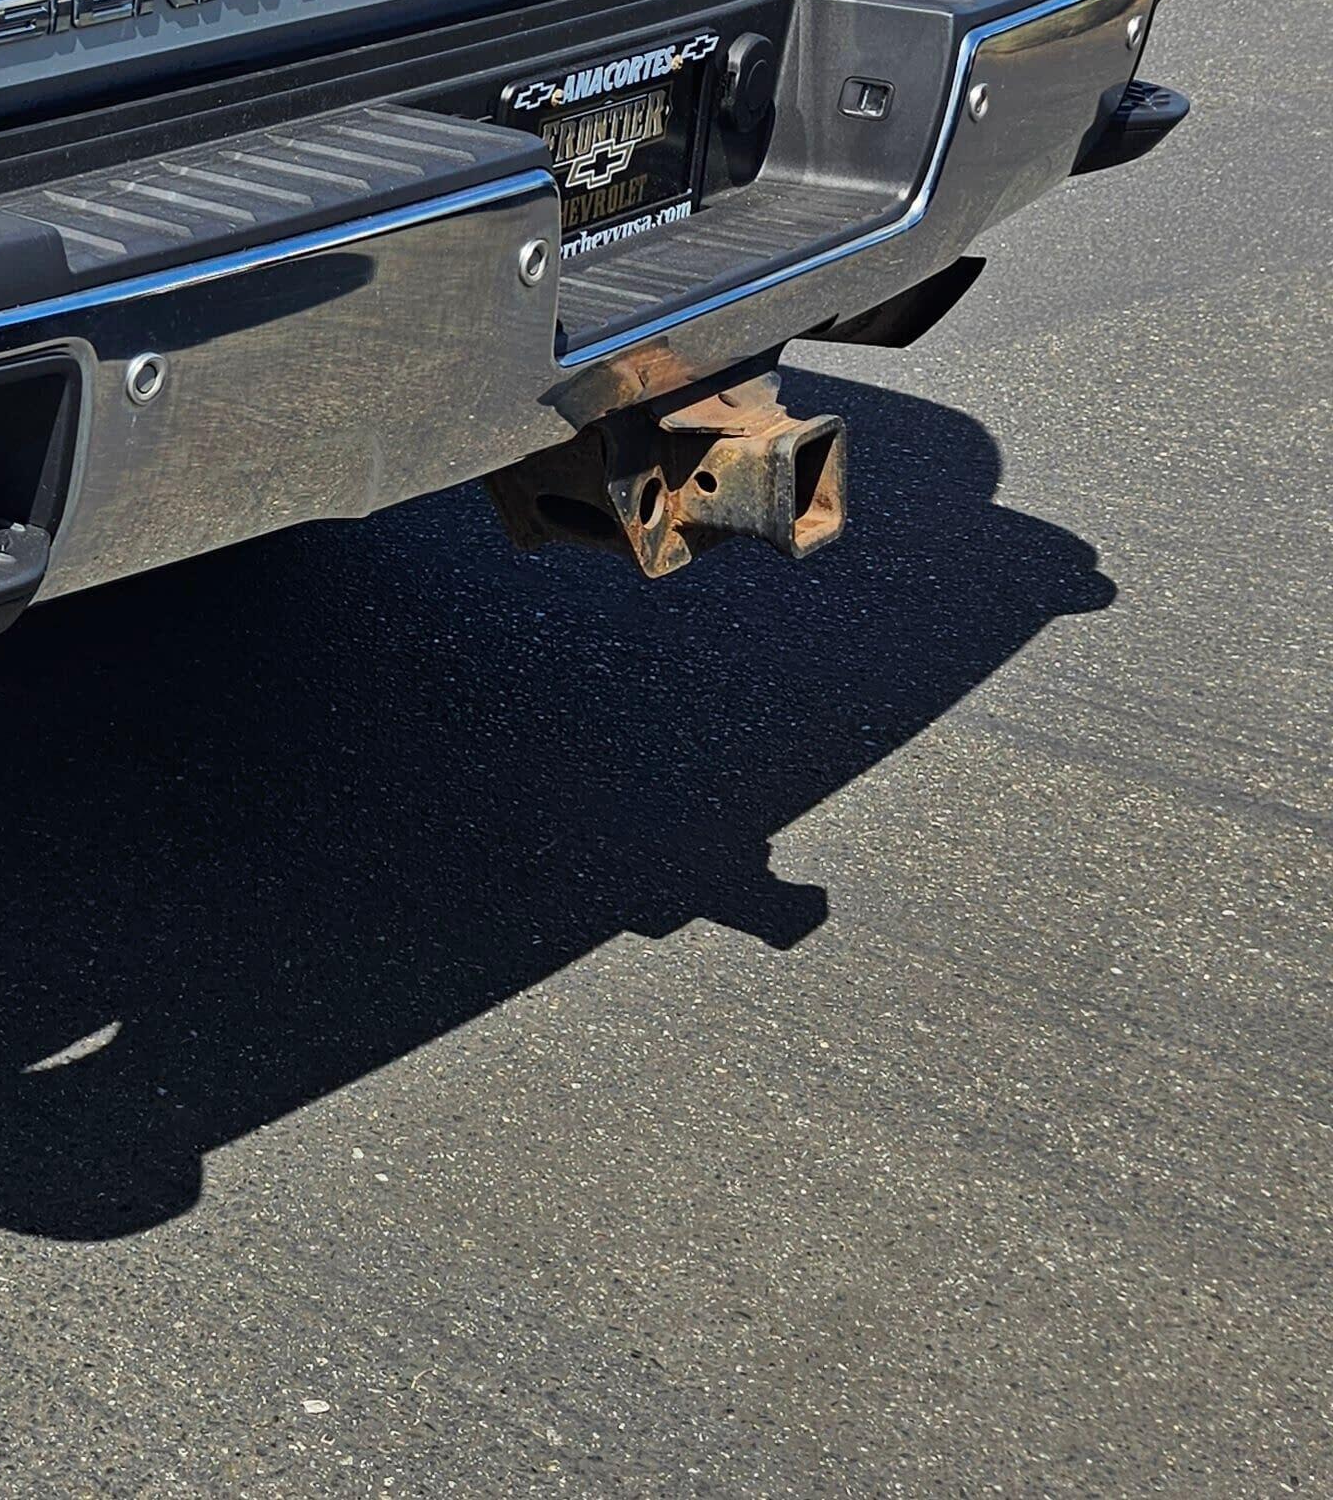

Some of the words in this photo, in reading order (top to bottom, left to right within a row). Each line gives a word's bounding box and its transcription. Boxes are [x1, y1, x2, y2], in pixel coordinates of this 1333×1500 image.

[560, 45, 676, 105] ANACORTES
[541, 88, 668, 163] FRONTIER
[560, 173, 649, 229] HEVROLET
